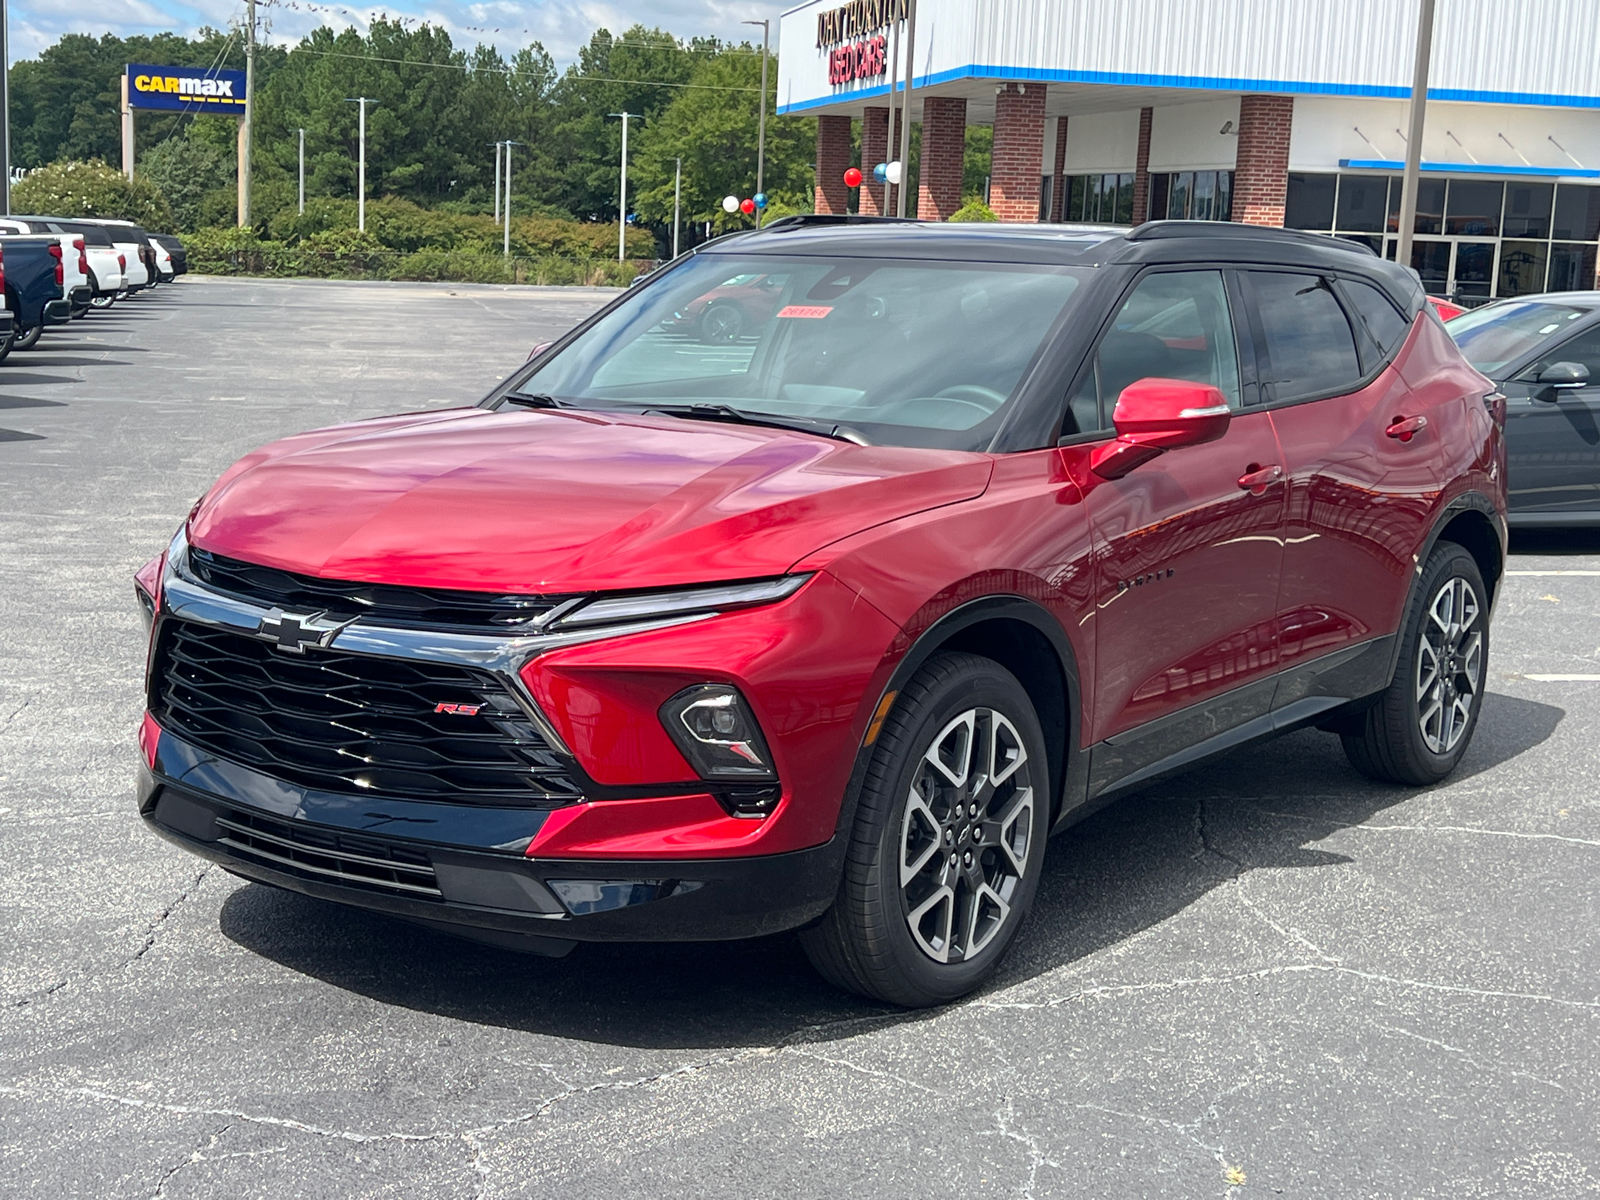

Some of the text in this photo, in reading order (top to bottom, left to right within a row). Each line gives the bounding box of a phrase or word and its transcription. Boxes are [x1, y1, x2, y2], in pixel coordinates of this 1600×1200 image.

[816, 7, 845, 48] JOHN
[828, 35, 886, 86] USED CARS
[434, 702, 480, 716] RS
